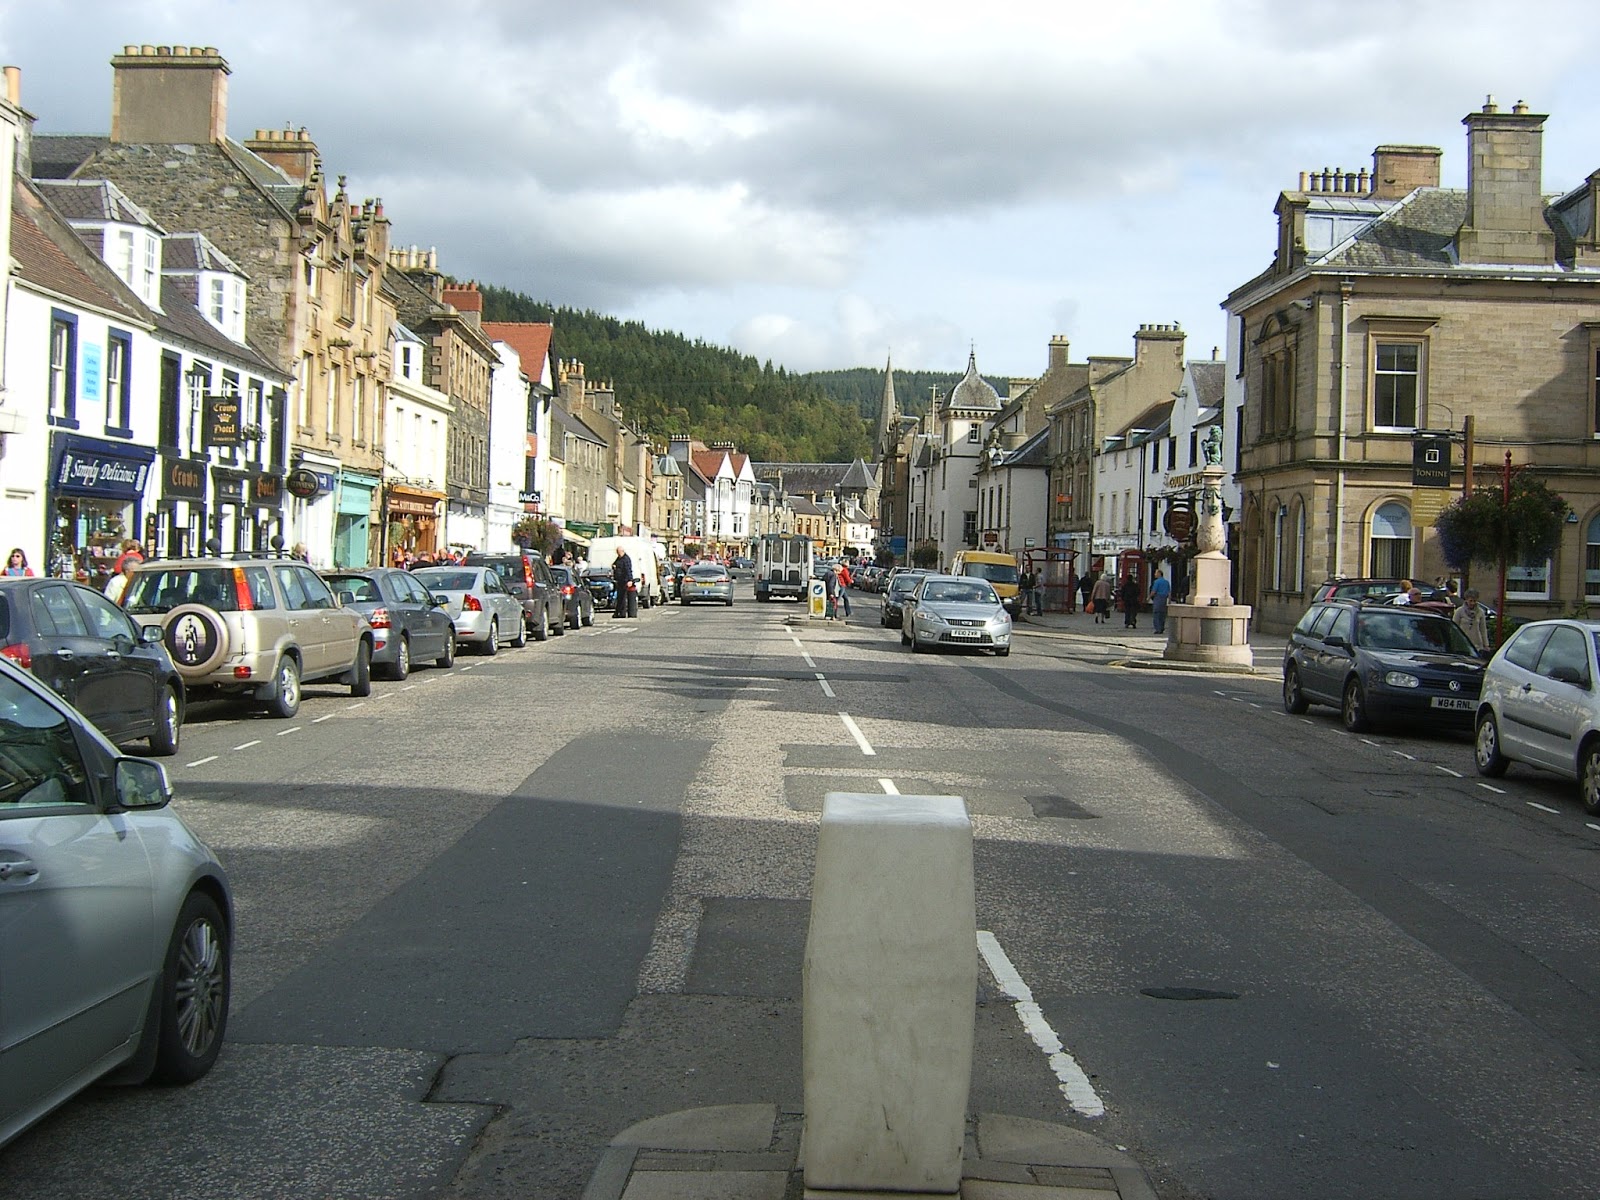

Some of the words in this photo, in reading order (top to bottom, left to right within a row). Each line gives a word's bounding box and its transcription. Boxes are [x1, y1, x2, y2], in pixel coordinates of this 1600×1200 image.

[70, 459, 100, 486] Simply
[99, 462, 137, 484] Delicious
[171, 464, 199, 489] Crown
[256, 474, 276, 498] Hotel
[1415, 467, 1448, 478] TONTINE
[1437, 698, 1455, 708] W84
[1456, 700, 1473, 710] RNL
